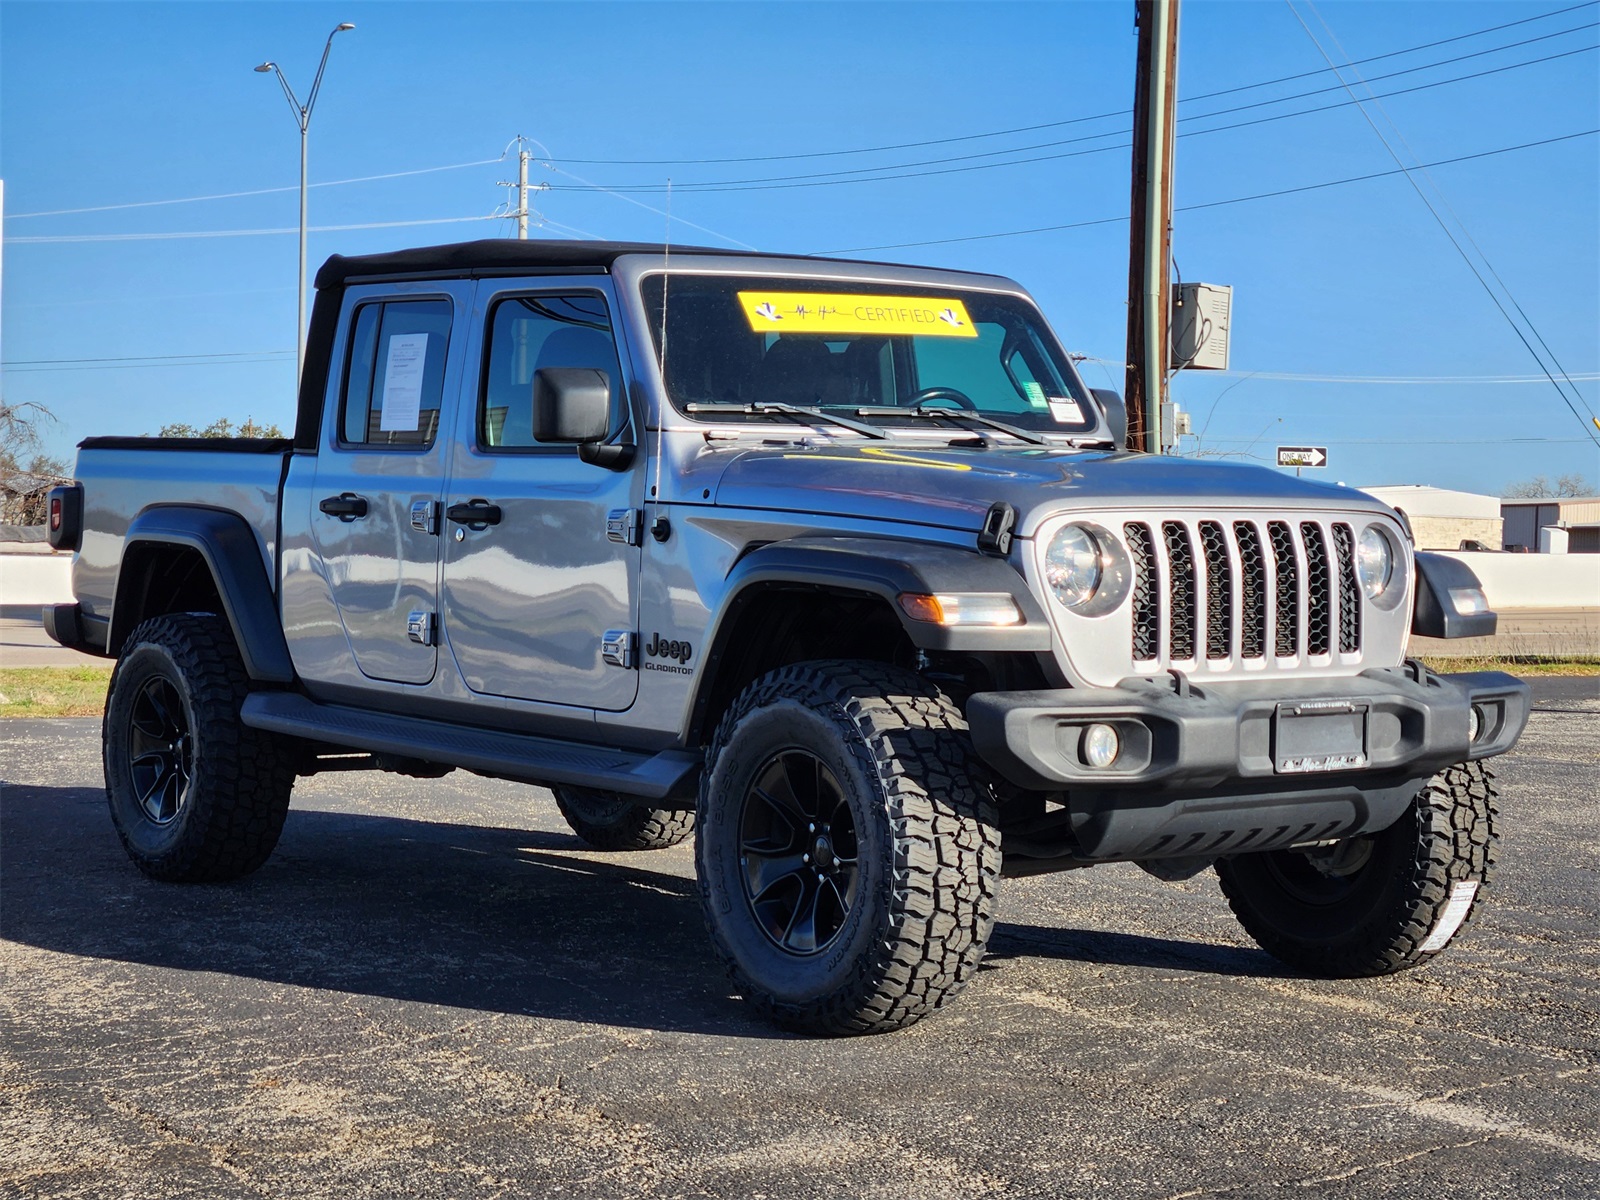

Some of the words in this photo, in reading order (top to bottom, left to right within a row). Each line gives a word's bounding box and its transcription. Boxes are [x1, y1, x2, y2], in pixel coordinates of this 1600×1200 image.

[854, 306, 936, 324] CERTIFIED
[1282, 452, 1295, 460] ONE
[646, 632, 692, 665] Jeep
[645, 662, 694, 675] GLADIATOR
